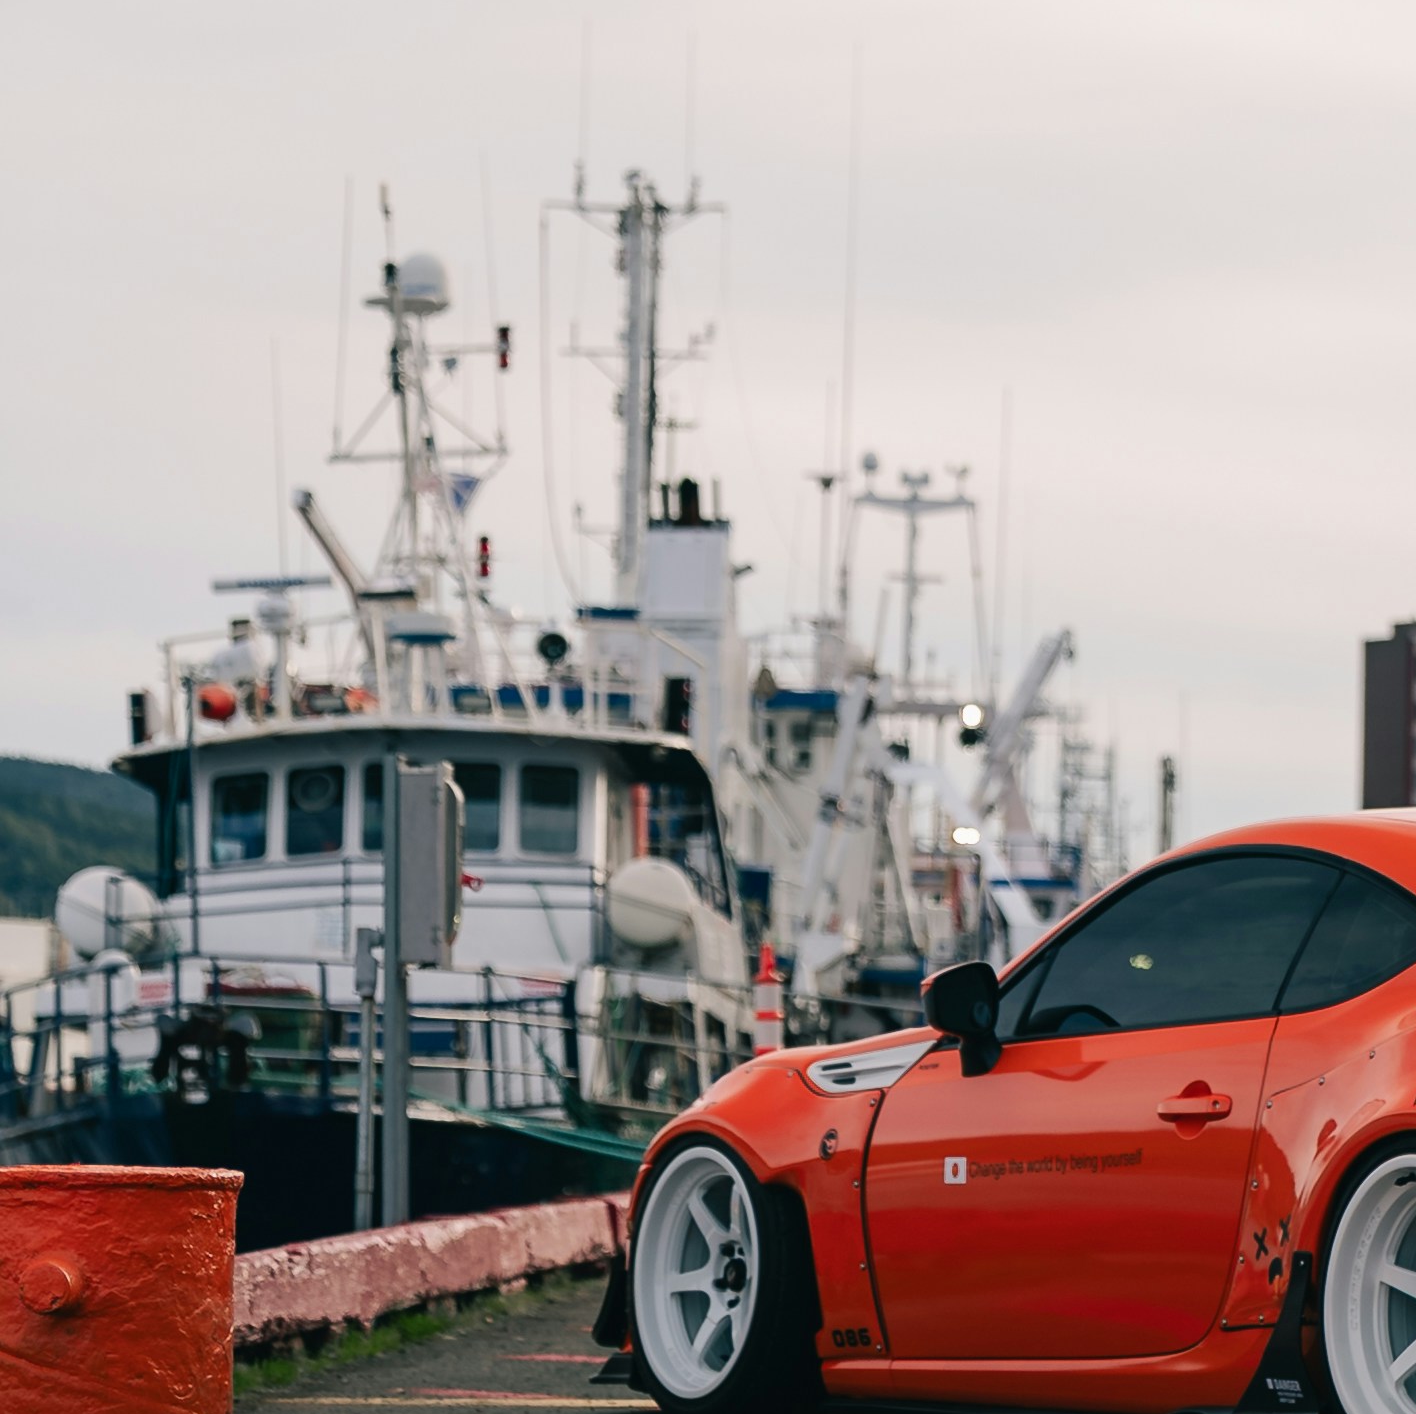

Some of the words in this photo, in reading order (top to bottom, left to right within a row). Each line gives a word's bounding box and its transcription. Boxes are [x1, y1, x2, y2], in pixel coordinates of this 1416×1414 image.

[969, 1161, 1006, 1181] Change
[1009, 1157, 1024, 1174] the
[1026, 1154, 1054, 1173] world
[1056, 1154, 1067, 1175] by
[1070, 1152, 1098, 1173] being
[1100, 1147, 1143, 1170] yourself
[831, 1327, 872, 1348] 086
